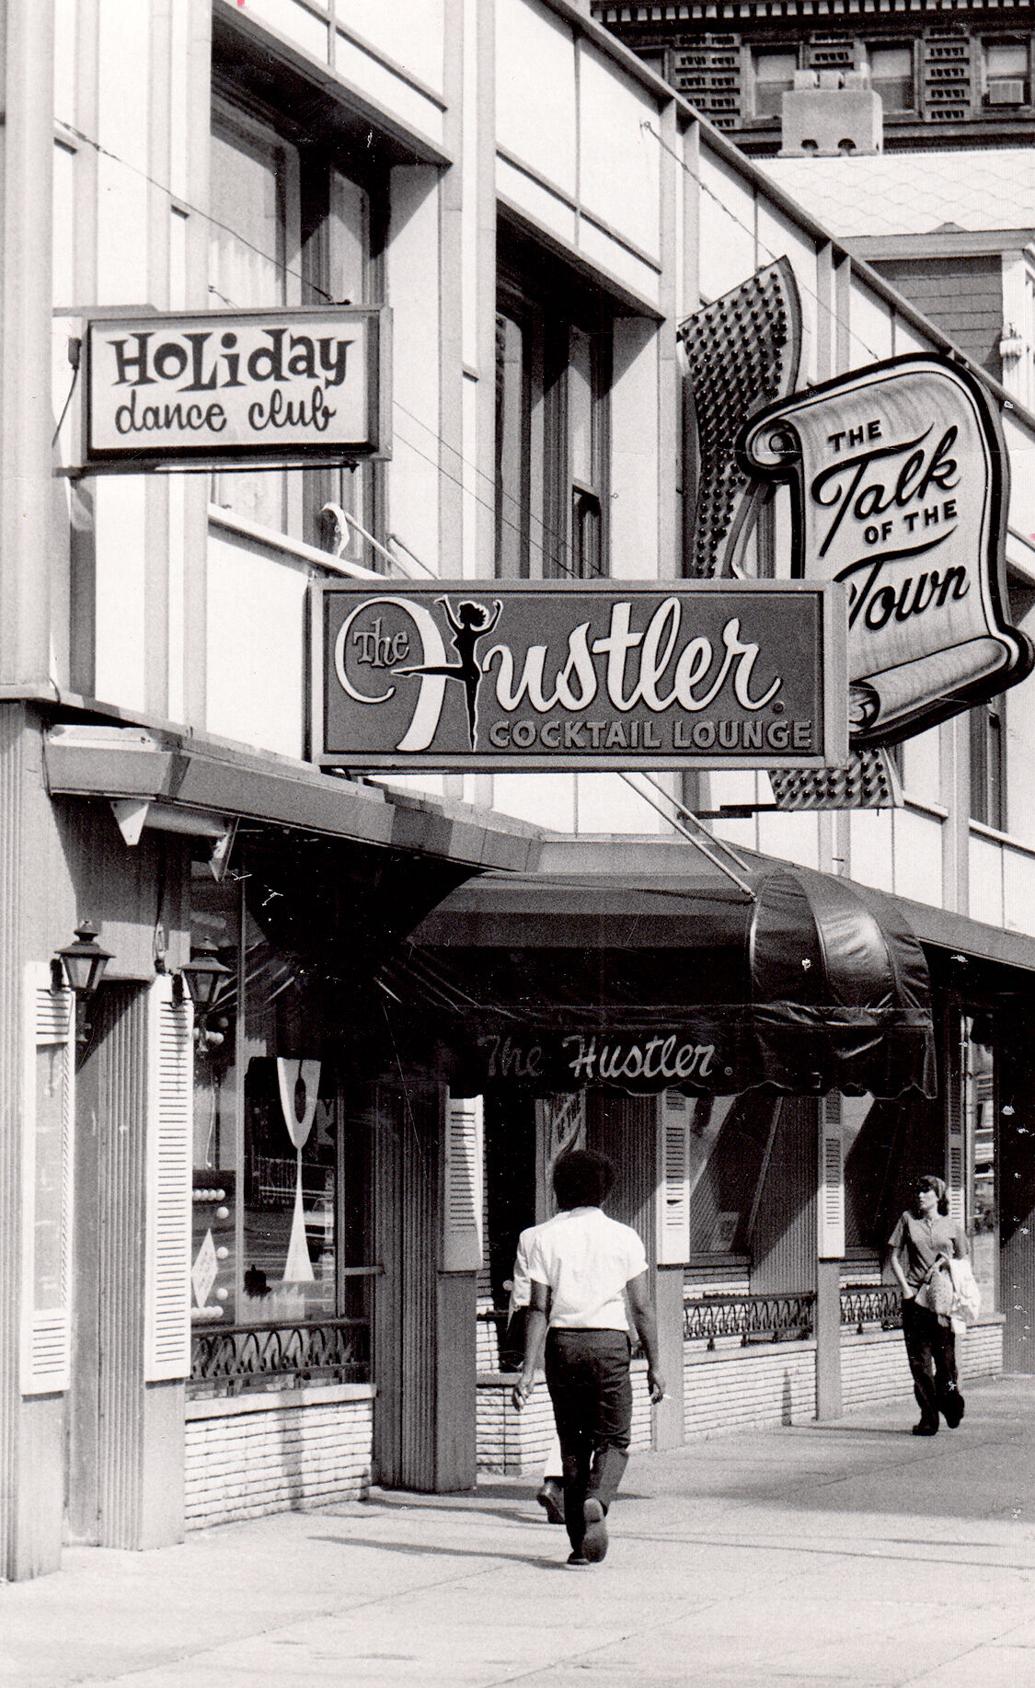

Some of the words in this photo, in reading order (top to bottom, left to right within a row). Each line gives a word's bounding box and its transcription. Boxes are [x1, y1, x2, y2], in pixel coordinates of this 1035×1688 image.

[115, 389, 227, 434] dance
[248, 386, 337, 431] club
[828, 420, 882, 451] THE
[811, 422, 961, 557] Talk
[864, 521, 893, 544] OF
[904, 499, 957, 531] THE
[833, 525, 970, 631] Town
[353, 618, 409, 668] The
[489, 719, 662, 749] COCKTAIL
[674, 719, 813, 749] LOUNGE
[477, 1034, 543, 1078] The
